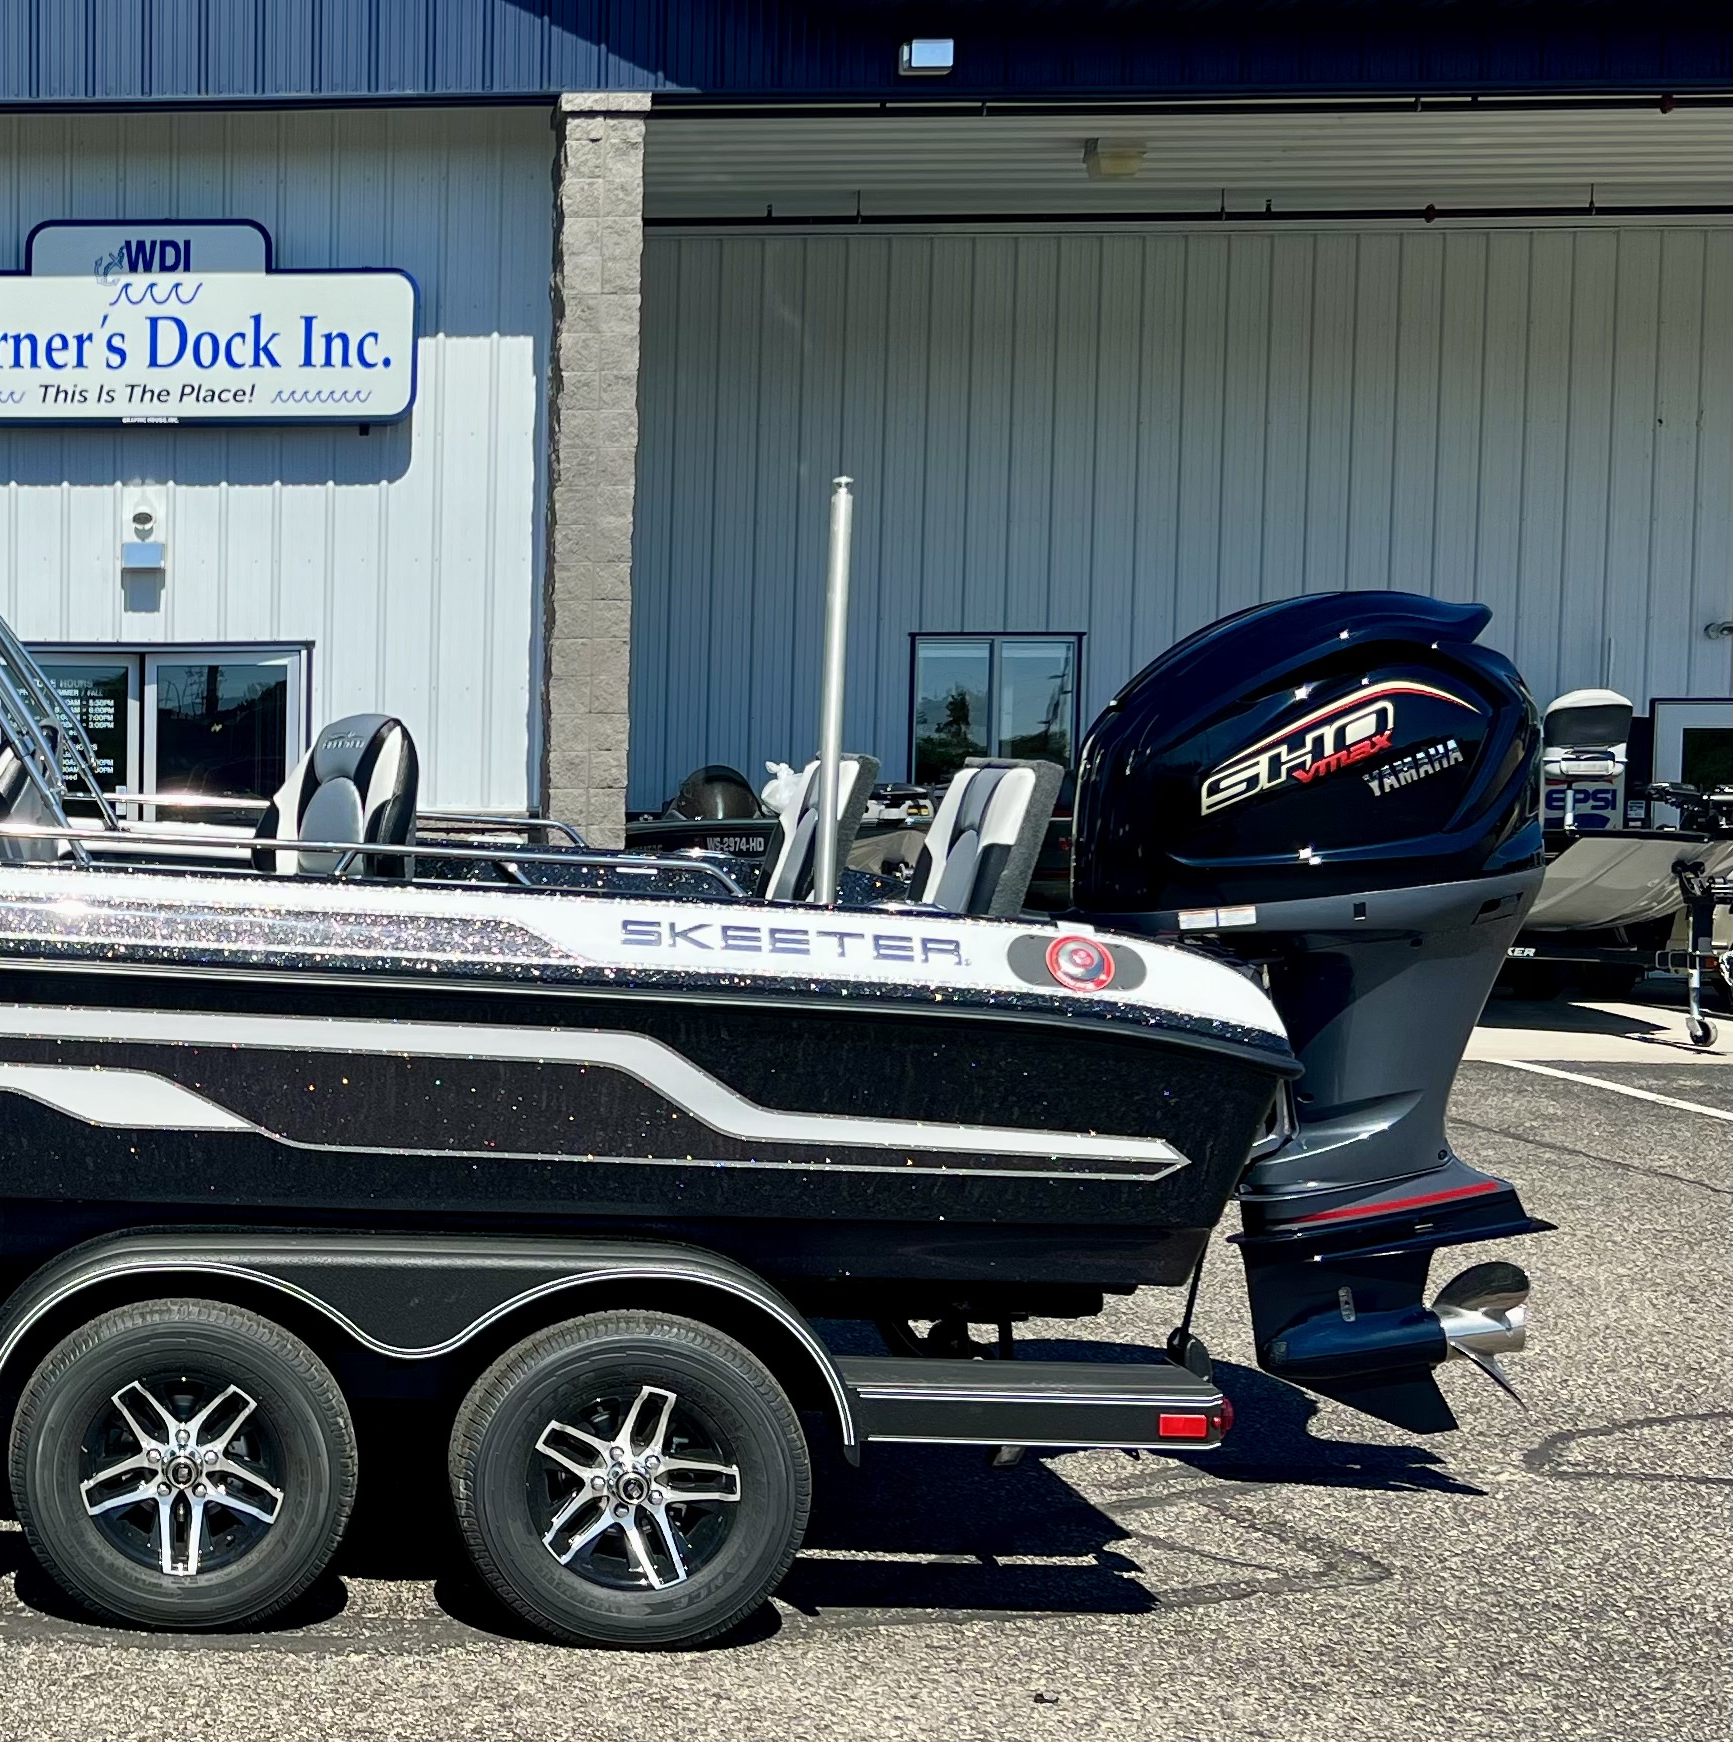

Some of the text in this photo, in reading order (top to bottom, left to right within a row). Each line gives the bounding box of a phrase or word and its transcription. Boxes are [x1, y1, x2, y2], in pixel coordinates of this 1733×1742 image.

[125, 239, 191, 273] WDI
[144, 312, 283, 370] Dock
[298, 315, 393, 370] Inc.
[38, 384, 256, 404] This Is The Place!
[1200, 700, 1395, 817] SHO
[1361, 738, 1465, 797] YAMAHA
[1545, 788, 1618, 811] EPSI
[706, 836, 766, 852] WS-2974-HD
[620, 919, 963, 967] SKEETER
